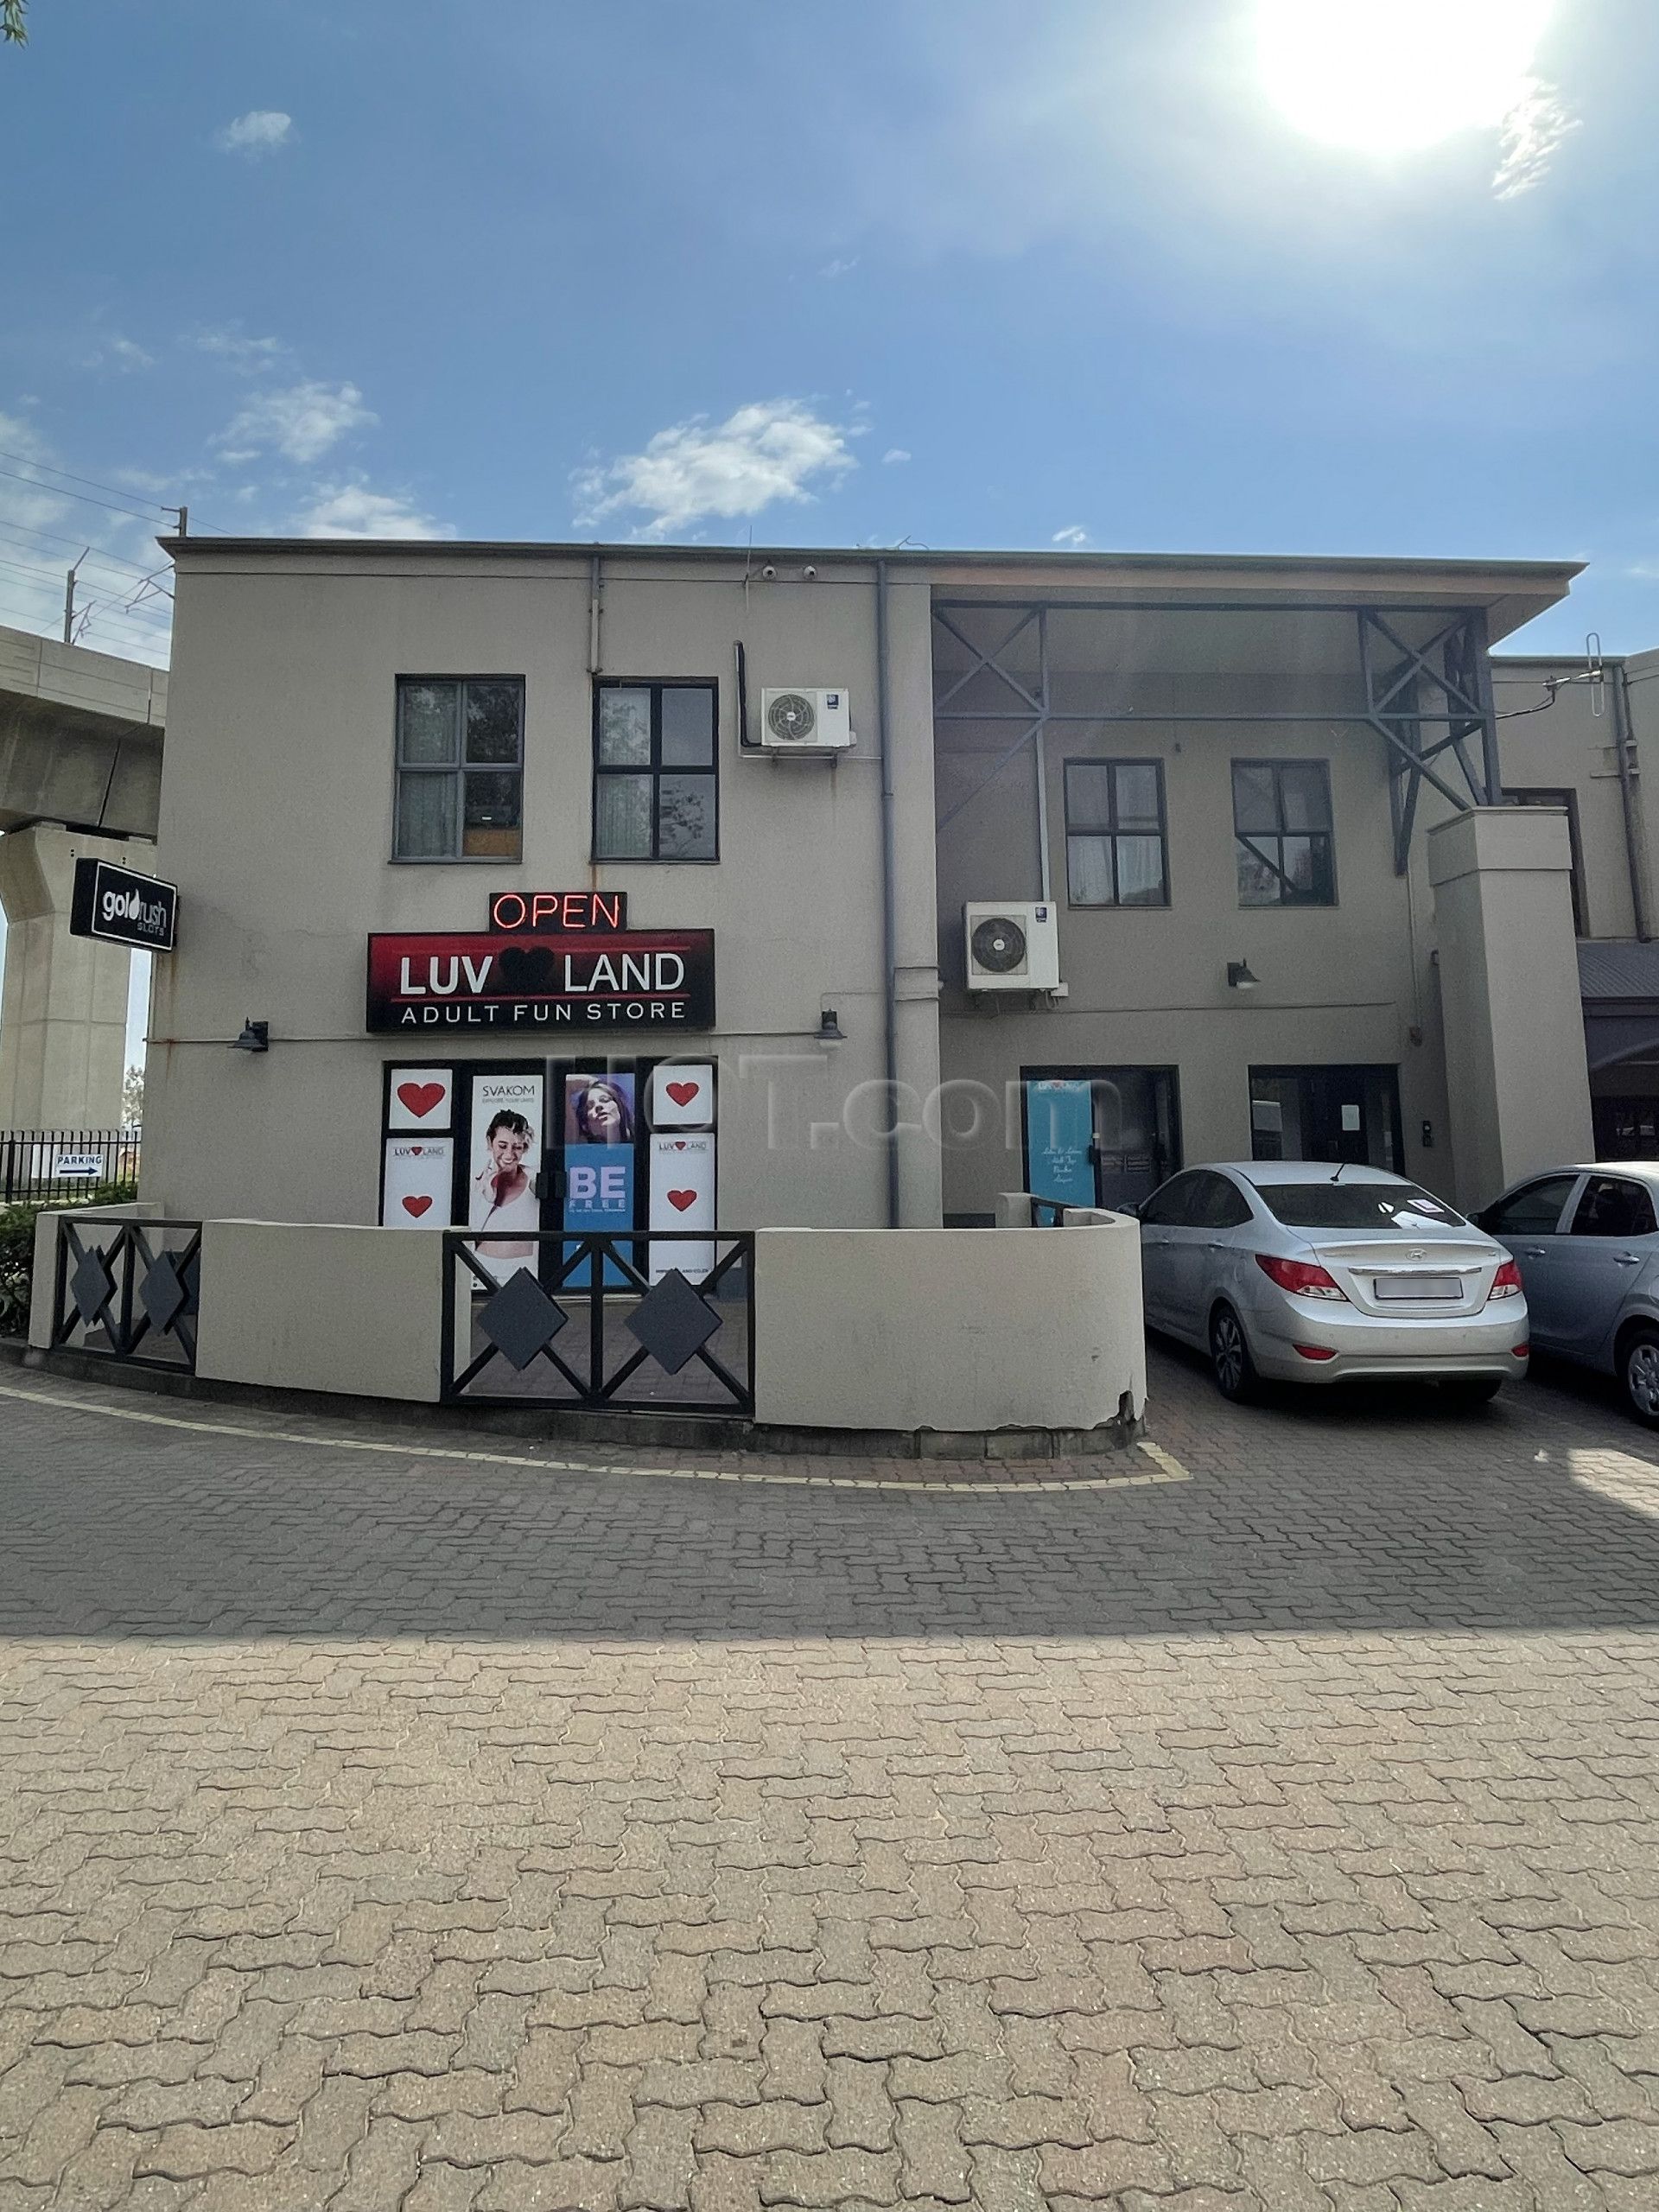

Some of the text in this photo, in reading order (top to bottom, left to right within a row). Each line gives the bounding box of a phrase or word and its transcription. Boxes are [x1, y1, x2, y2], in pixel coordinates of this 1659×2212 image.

[101, 887, 167, 928] goldrush
[493, 893, 620, 929] OPEN
[137, 921, 165, 937] SLOTS
[400, 952, 684, 995] LUV LAND
[401, 1001, 685, 1025] ADULT FUN STORE
[482, 1084, 535, 1097] SVAKOM
[57, 1155, 103, 1165] PARKING
[569, 1166, 626, 1199] BE
